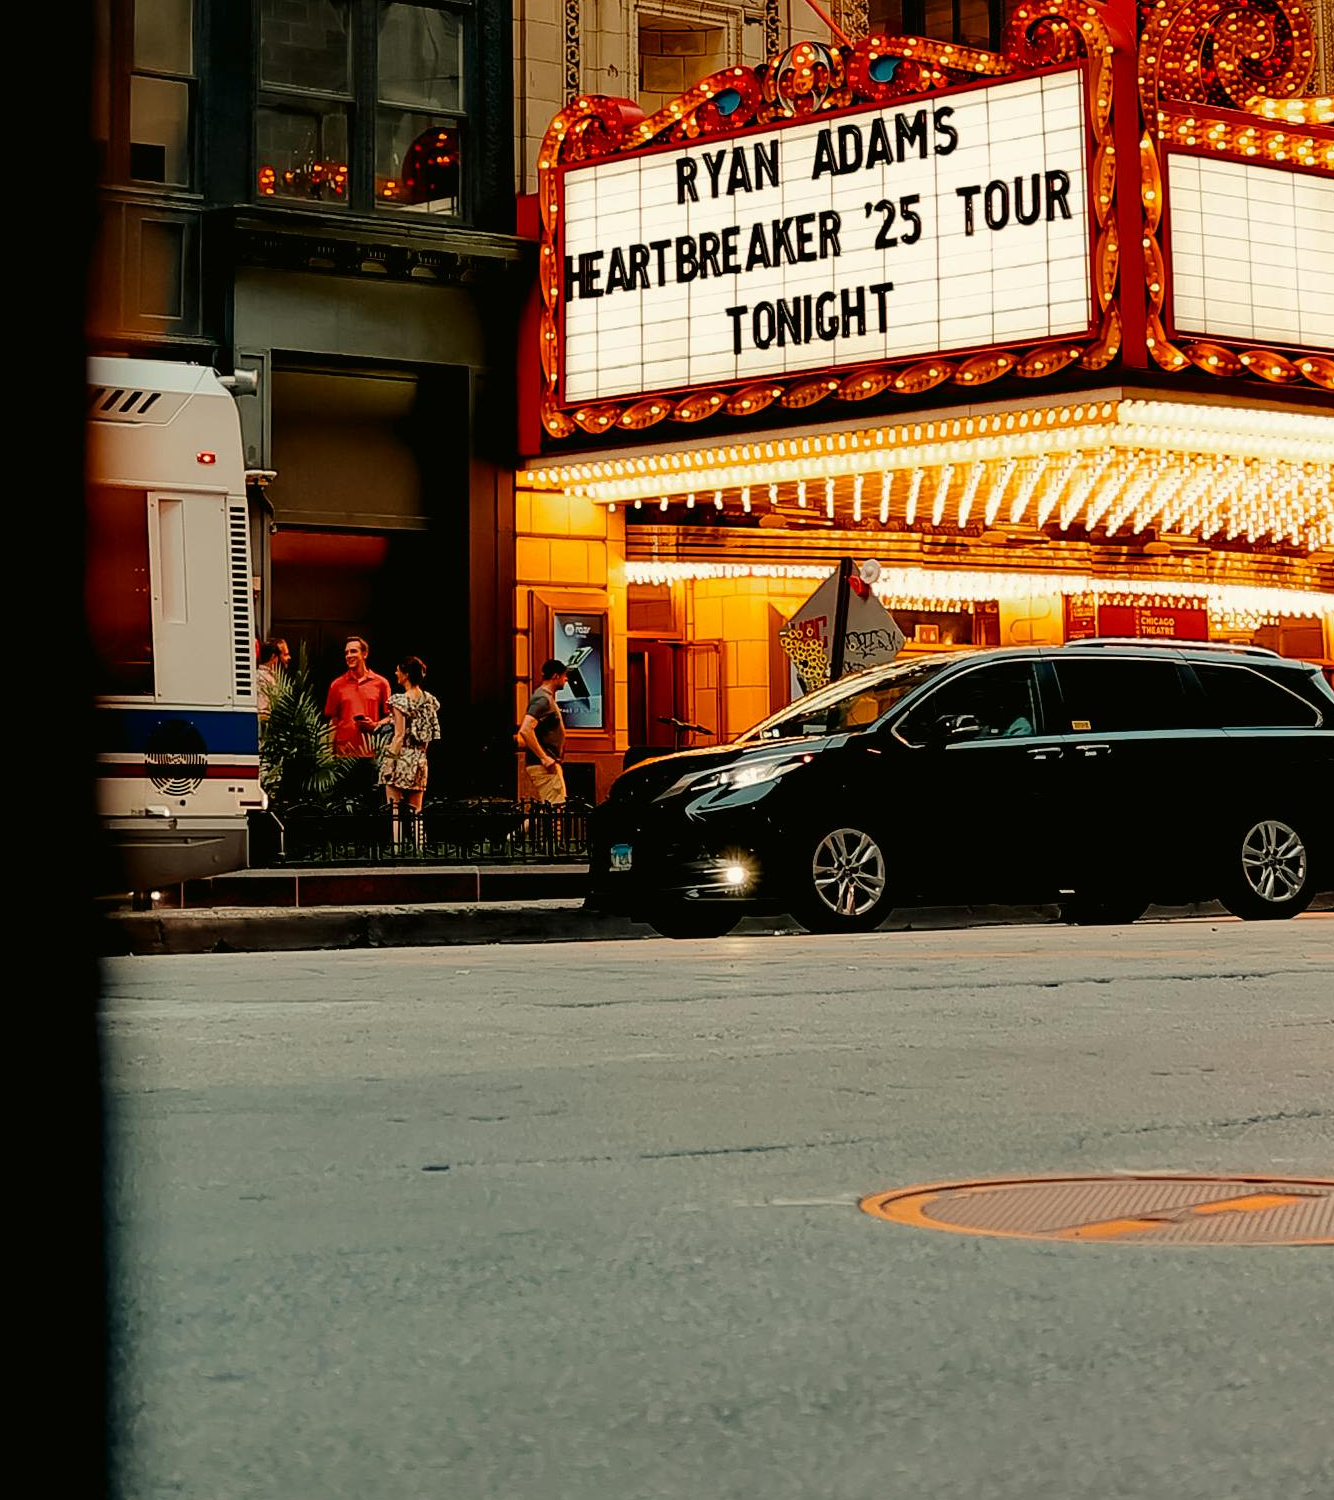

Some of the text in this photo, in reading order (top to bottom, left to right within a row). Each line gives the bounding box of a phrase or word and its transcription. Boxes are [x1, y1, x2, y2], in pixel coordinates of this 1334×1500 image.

[676, 106, 959, 204] RYAN ADAMS
[565, 169, 1073, 302] HEARTBREAKER '25 TOUR
[725, 281, 895, 355] TONIGHT
[1141, 616, 1175, 626] CHICAGO
[1141, 626, 1175, 635] THEATRE
